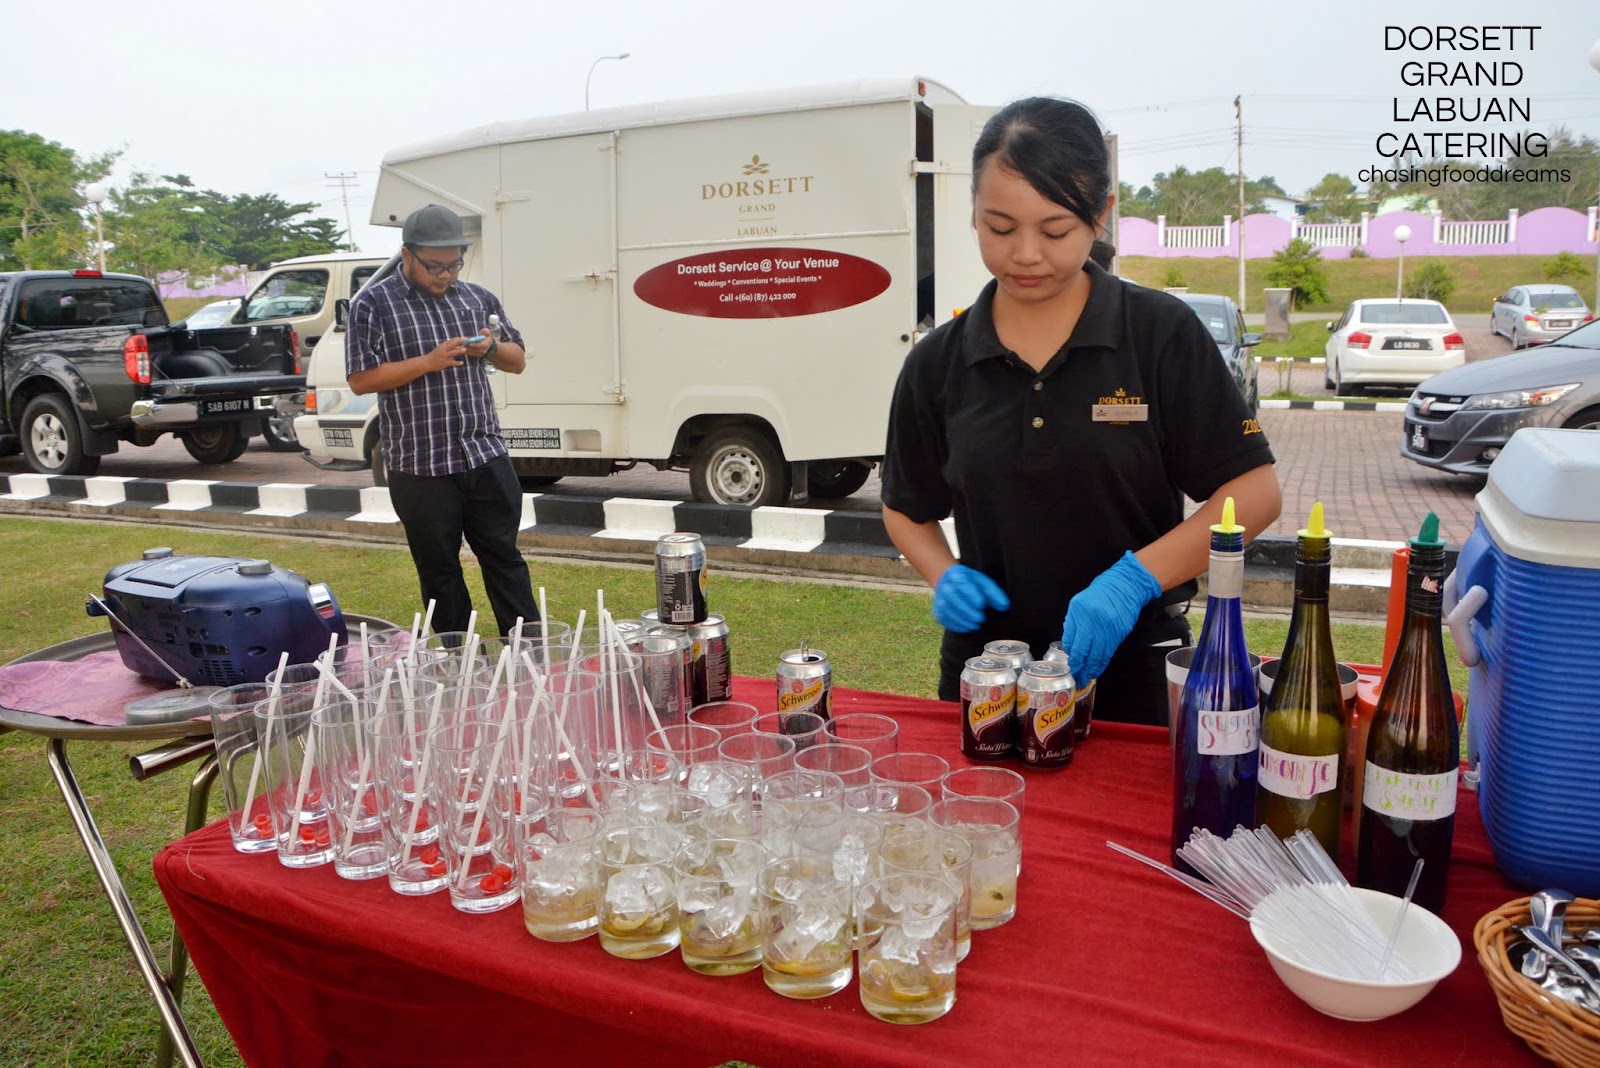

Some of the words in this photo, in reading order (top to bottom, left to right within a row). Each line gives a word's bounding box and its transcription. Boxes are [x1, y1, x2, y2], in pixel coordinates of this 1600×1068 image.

[701, 176, 814, 200] DORSETT
[738, 203, 776, 214] GRAND
[737, 226, 778, 236] LABUAN
[677, 263, 716, 275] Dorsett
[774, 258, 801, 270] Your
[803, 256, 840, 269] Venue
[697, 280, 727, 288] Weddings
[731, 277, 769, 286] Conventions
[774, 276, 796, 285] Special
[796, 275, 817, 283] Events
[719, 293, 734, 302] Call
[753, 292, 768, 302] (87)
[769, 293, 782, 302] 422
[782, 292, 797, 300] 000
[207, 402, 223, 412] SAB
[223, 400, 242, 411] 6107
[1098, 396, 1142, 405] DORSETT
